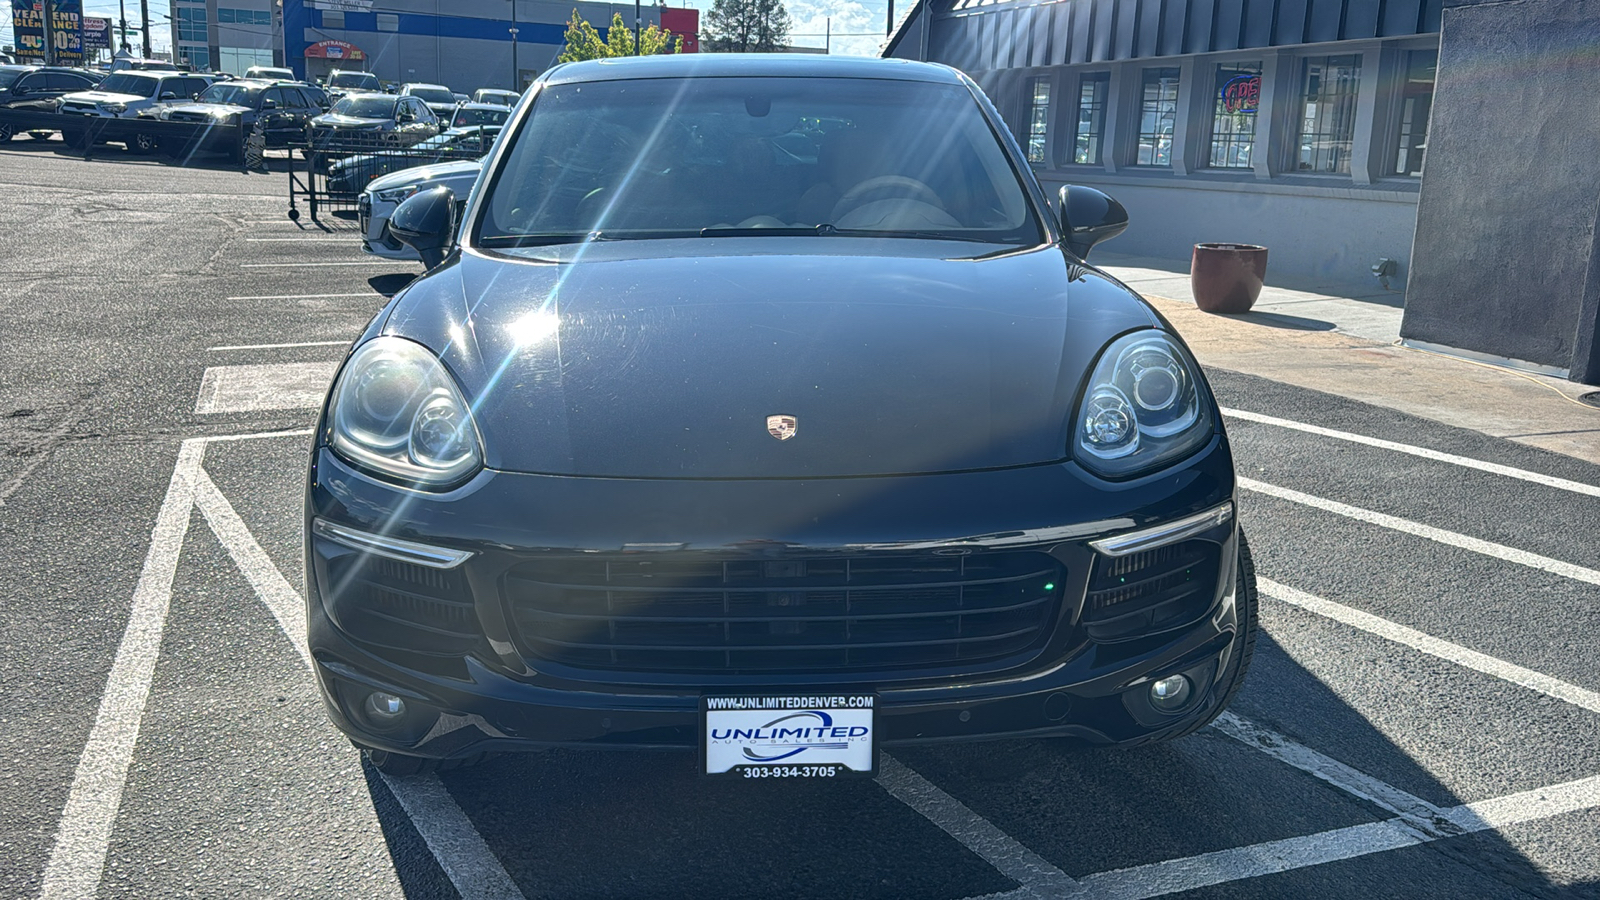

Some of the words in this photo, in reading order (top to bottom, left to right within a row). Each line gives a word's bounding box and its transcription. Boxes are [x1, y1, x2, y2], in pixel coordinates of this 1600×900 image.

[52, 11, 79, 21] END
[14, 18, 79, 30] CLEANCE
[318, 40, 351, 48] ENTRANCE
[59, 51, 82, 59] Delivery
[711, 726, 869, 740] UNLIMITED
[743, 766, 836, 779] 303-934-3705
